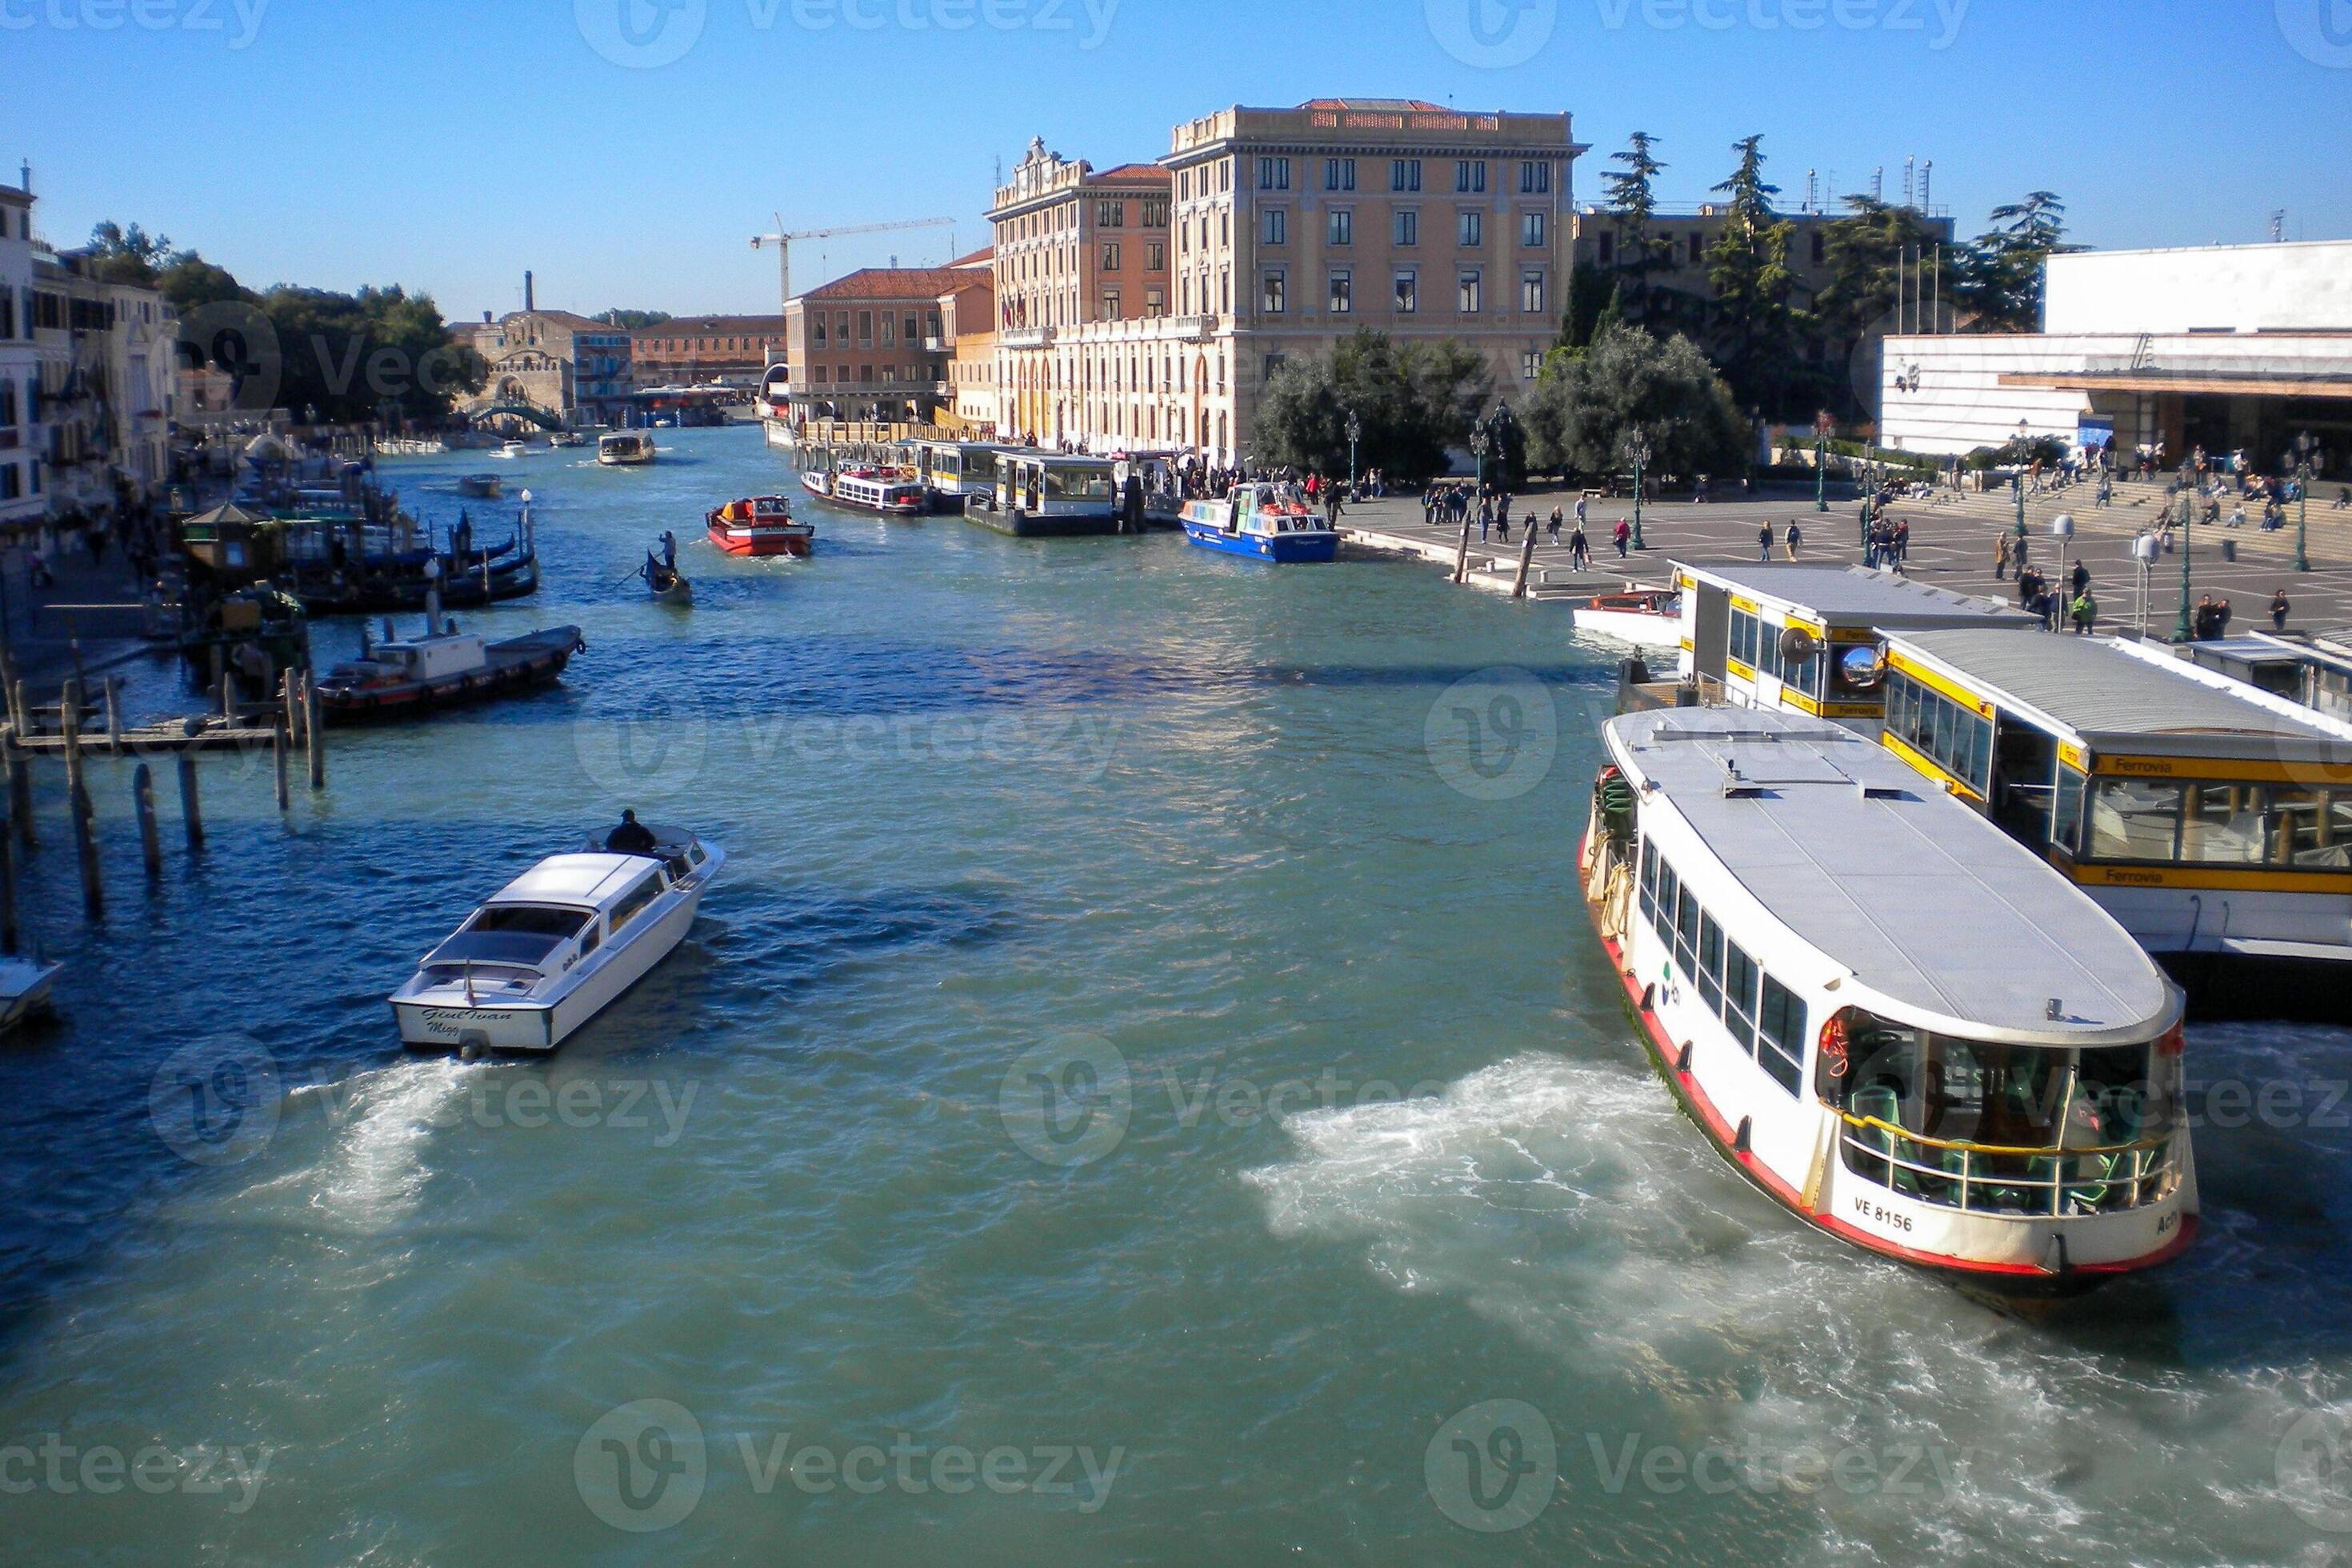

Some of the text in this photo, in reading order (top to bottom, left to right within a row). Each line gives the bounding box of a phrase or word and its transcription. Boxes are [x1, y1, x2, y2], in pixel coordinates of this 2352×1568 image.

[2116, 758, 2172, 774] Ferrovia
[2106, 869, 2162, 883] Ferrovia
[1855, 1197, 1912, 1232] VE 8156
